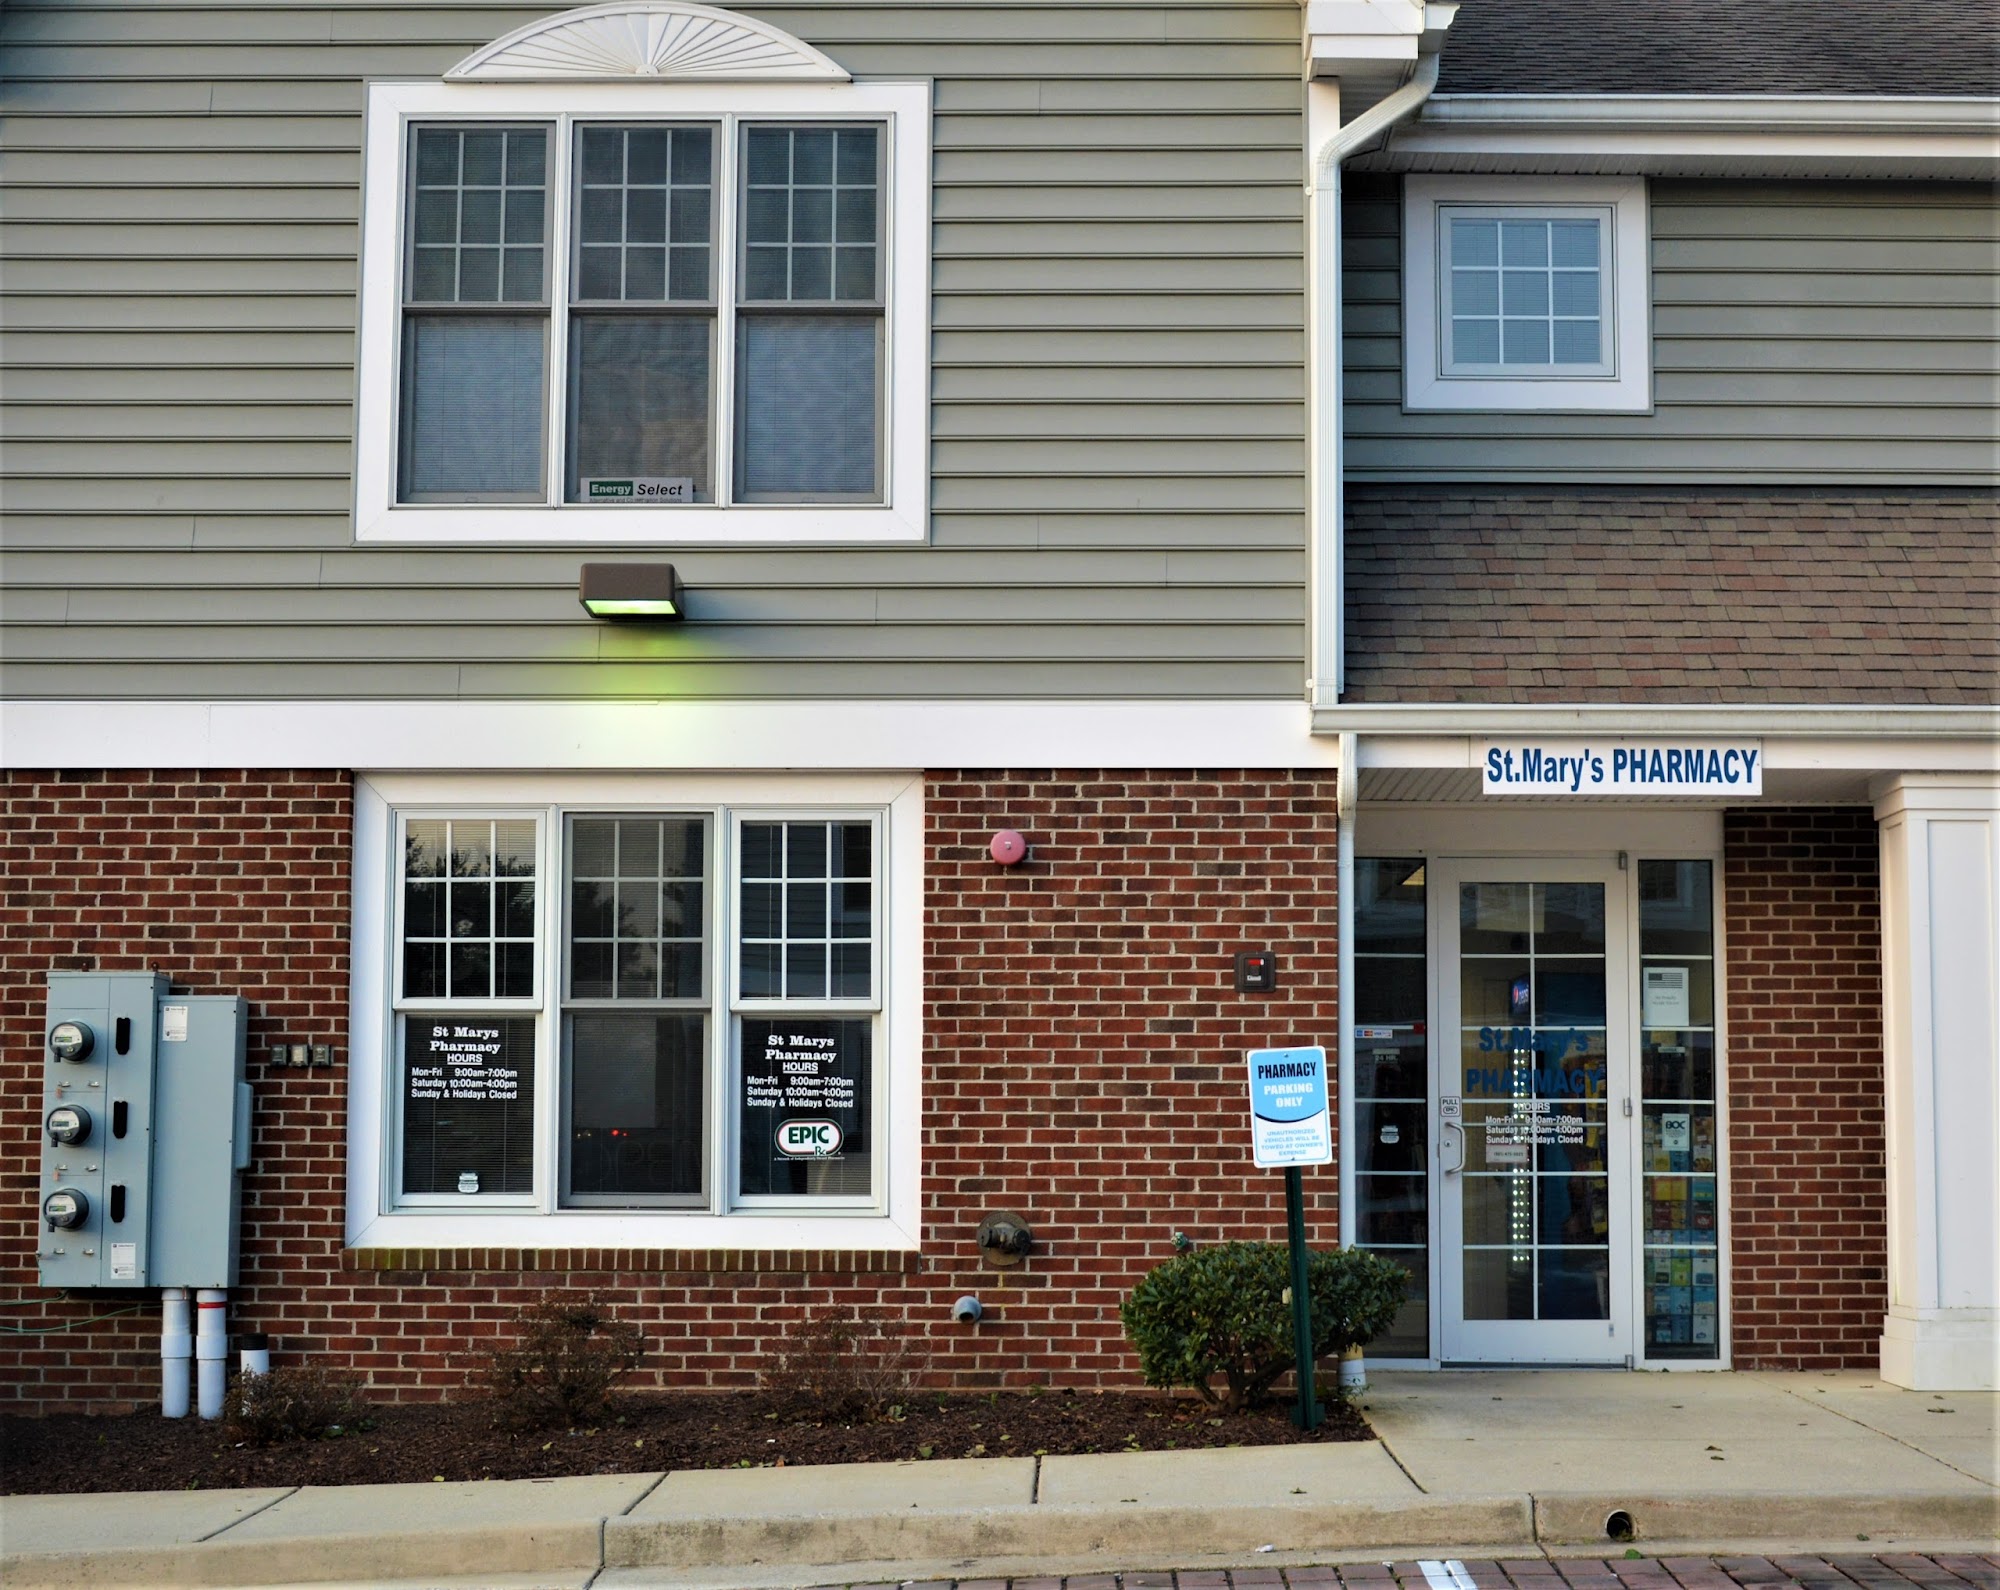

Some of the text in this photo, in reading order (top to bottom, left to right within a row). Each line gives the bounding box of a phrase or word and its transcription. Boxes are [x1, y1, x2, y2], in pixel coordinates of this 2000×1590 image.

[592, 484, 682, 495] Energy Select
[1488, 748, 1757, 791] St.Mary's PHARMACY
[433, 1027, 498, 1040] St Marys
[768, 1035, 834, 1048] St Marys
[430, 1041, 501, 1054] Pharmacy
[447, 1054, 482, 1063] HOURS
[765, 1049, 836, 1063] Pharmacy
[783, 1063, 818, 1071] HOURS
[1258, 1062, 1316, 1079] PHARMACY
[412, 1068, 517, 1078] Mon-Fri 9:00am-7:00pm
[412, 1078, 517, 1089] Saturday 10:00am-4:00pm
[747, 1076, 853, 1086] Mon-Fri 9:00am-7:00pm
[1467, 1069, 1602, 1093] PHARMACY
[411, 1089, 441, 1099] Sunday
[453, 1090, 486, 1100] Holidays
[489, 1090, 517, 1099] Closed
[747, 1087, 853, 1098] Saturday 10:00am-4:00pm
[1264, 1083, 1313, 1095] PARKING
[747, 1098, 776, 1107] Sunday
[789, 1098, 822, 1108] Holidays
[826, 1099, 853, 1107] Closed
[1276, 1097, 1303, 1108] ONLY
[1525, 1116, 1582, 1124] 9:00am-7:00pm
[1666, 1121, 1686, 1129] BOC
[789, 1126, 829, 1144] EPIC
[1486, 1126, 1518, 1134] Saturday
[1486, 1136, 1513, 1144] Sunday
[1524, 1136, 1555, 1144] Holidays
